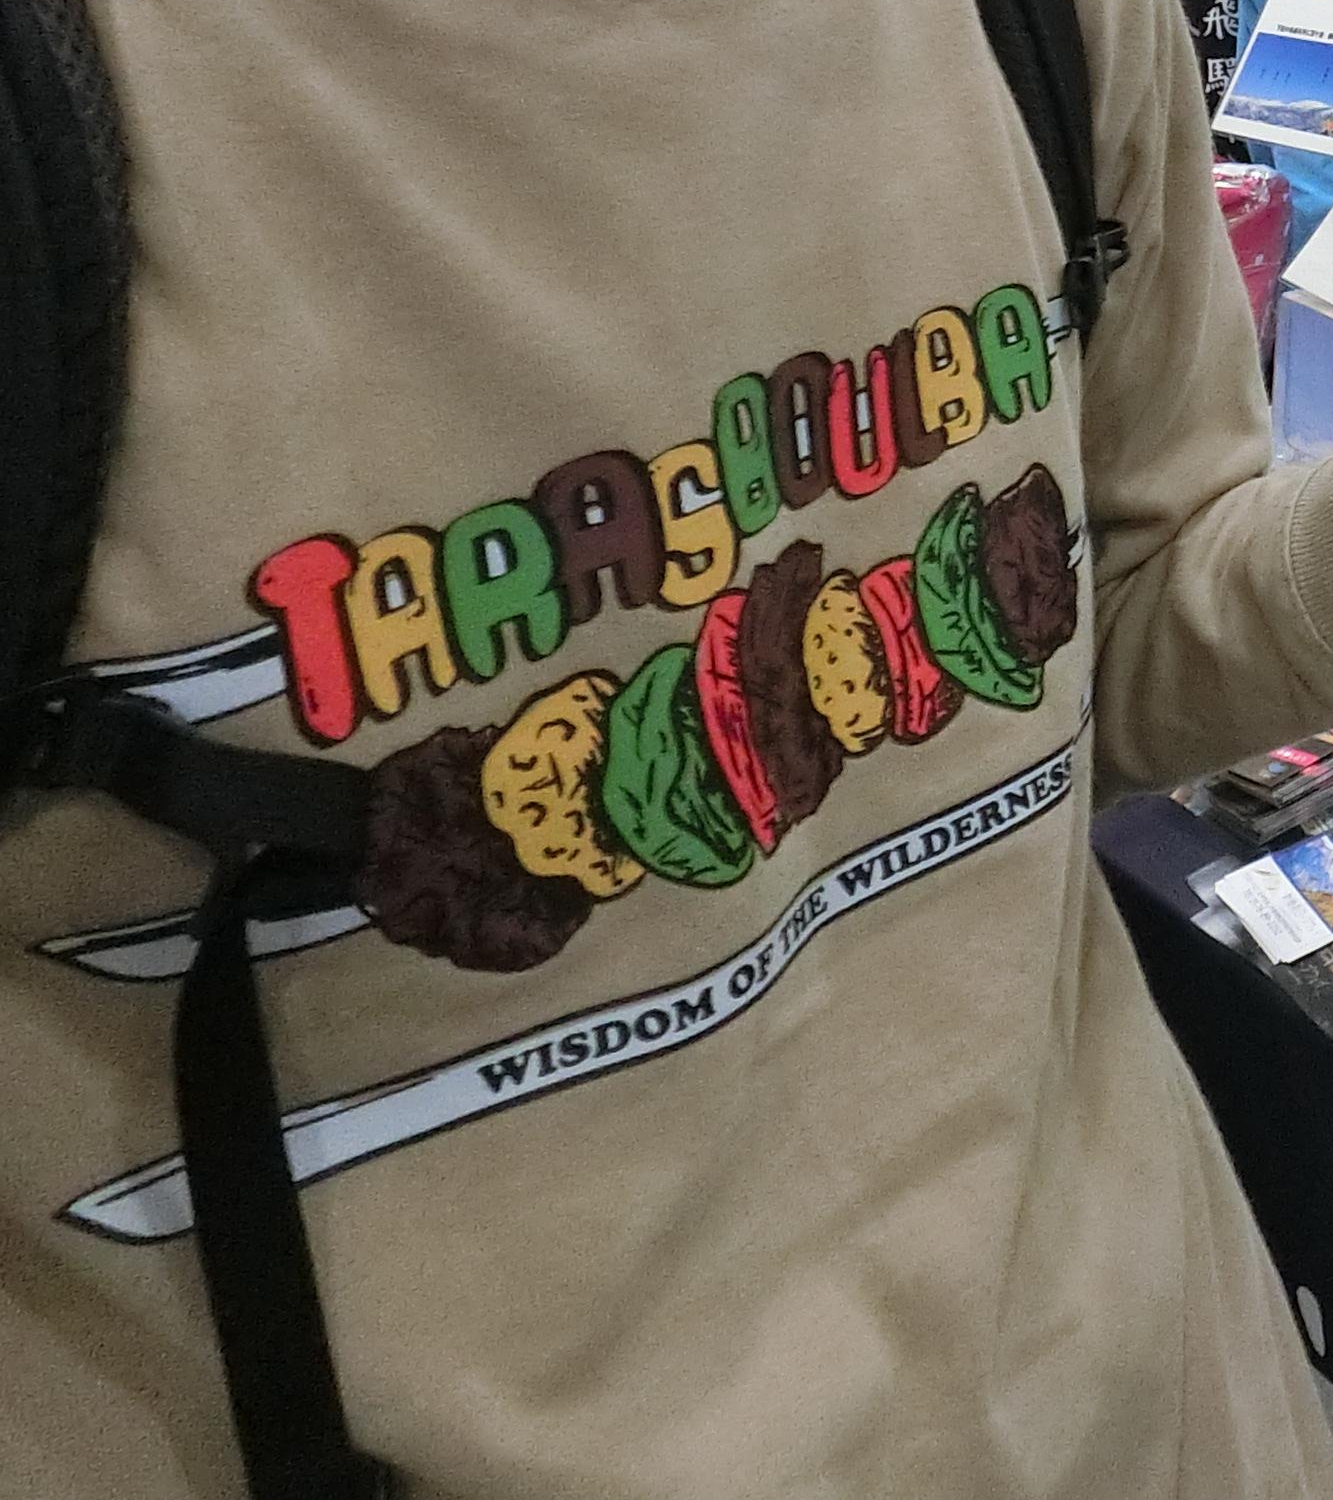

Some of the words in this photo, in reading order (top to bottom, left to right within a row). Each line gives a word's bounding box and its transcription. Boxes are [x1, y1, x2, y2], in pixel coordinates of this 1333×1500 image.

[476, 982, 717, 1096] WISDOM
[728, 944, 776, 1000] OF
[781, 883, 829, 957] THE
